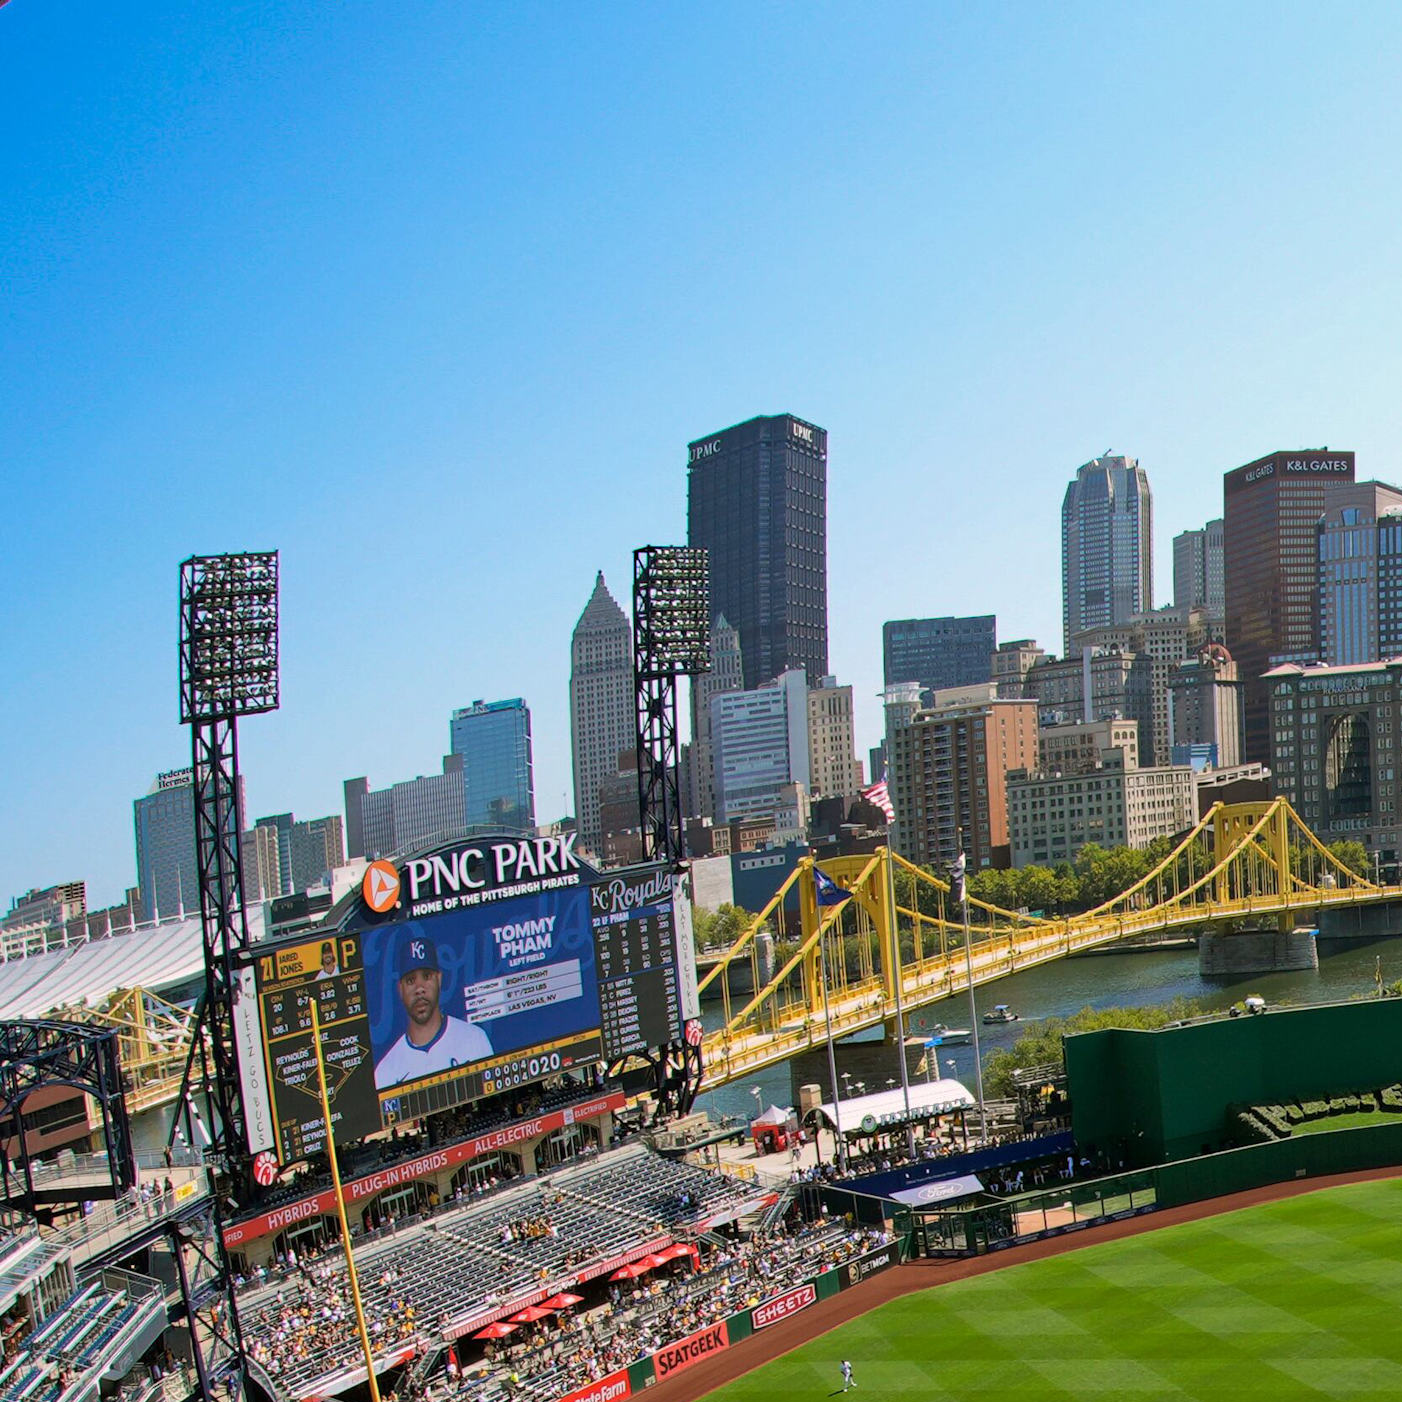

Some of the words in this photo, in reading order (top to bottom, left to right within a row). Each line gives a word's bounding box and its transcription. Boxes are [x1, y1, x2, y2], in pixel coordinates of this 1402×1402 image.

[792, 422, 814, 443] UPMC
[689, 439, 722, 463] UPMC
[1256, 462, 1275, 480] GATES
[1286, 460, 1309, 472] K&L
[1310, 460, 1348, 472] GATES
[406, 847, 486, 900] PNC
[491, 832, 581, 884] PARK
[412, 898, 442, 917] HOME
[444, 896, 458, 911] OF
[461, 891, 481, 907] THE
[481, 882, 541, 903] PITTSBURGH
[542, 873, 580, 892] PIRATES
[591, 886, 609, 911] KC
[609, 870, 672, 914] Royals
[609, 911, 629, 924] PHAM
[492, 915, 556, 944] TOMMY
[341, 939, 356, 968] P
[500, 932, 552, 959] PHAM
[260, 956, 275, 982] 21
[280, 960, 303, 977] JONES
[508, 955, 526, 968] LEFT
[526, 952, 546, 964] FIELD
[505, 969, 549, 986] RIGHT/RIGHT
[535, 982, 548, 992] LBS
[273, 1003, 283, 1013] 20
[320, 989, 336, 1000] 3.82
[508, 1001, 521, 1012] LAS
[546, 994, 557, 1002] NV
[272, 1024, 289, 1036] 108.1
[299, 1018, 311, 1028] 9.6
[324, 1011, 336, 1021] 2.6
[348, 1004, 361, 1015] 3.71
[340, 1035, 360, 1047] COOK
[276, 1049, 309, 1066] REYNOLDS
[326, 1045, 360, 1062] GONZALES
[342, 1056, 362, 1069] TELLEZ
[249, 1065, 259, 1089] GO
[284, 1073, 307, 1086] TRIOLO
[484, 1070, 492, 1080] 0
[494, 1067, 501, 1077] 0
[503, 1065, 510, 1074] 0
[511, 1062, 519, 1072] 0
[486, 1082, 493, 1092] 0
[496, 1080, 503, 1089] 0
[504, 1077, 511, 1087] 0
[513, 1074, 520, 1084] 0
[574, 1101, 607, 1119] ELECTRIFIED
[252, 1095, 265, 1146] BUCS
[284, 1140, 290, 1150] 2
[285, 1151, 292, 1161] 3
[304, 1141, 322, 1154] CRUZ
[267, 1199, 320, 1231] HYBRIDS
[351, 1168, 400, 1198] PLUG-IN
[400, 1153, 448, 1182] HYBRIDS
[474, 1119, 544, 1156] ALL-ELECTRIC
[860, 1254, 890, 1275] BETMGM
[755, 1286, 813, 1324] SHEETZ
[658, 1326, 725, 1376] SEATGEEK
